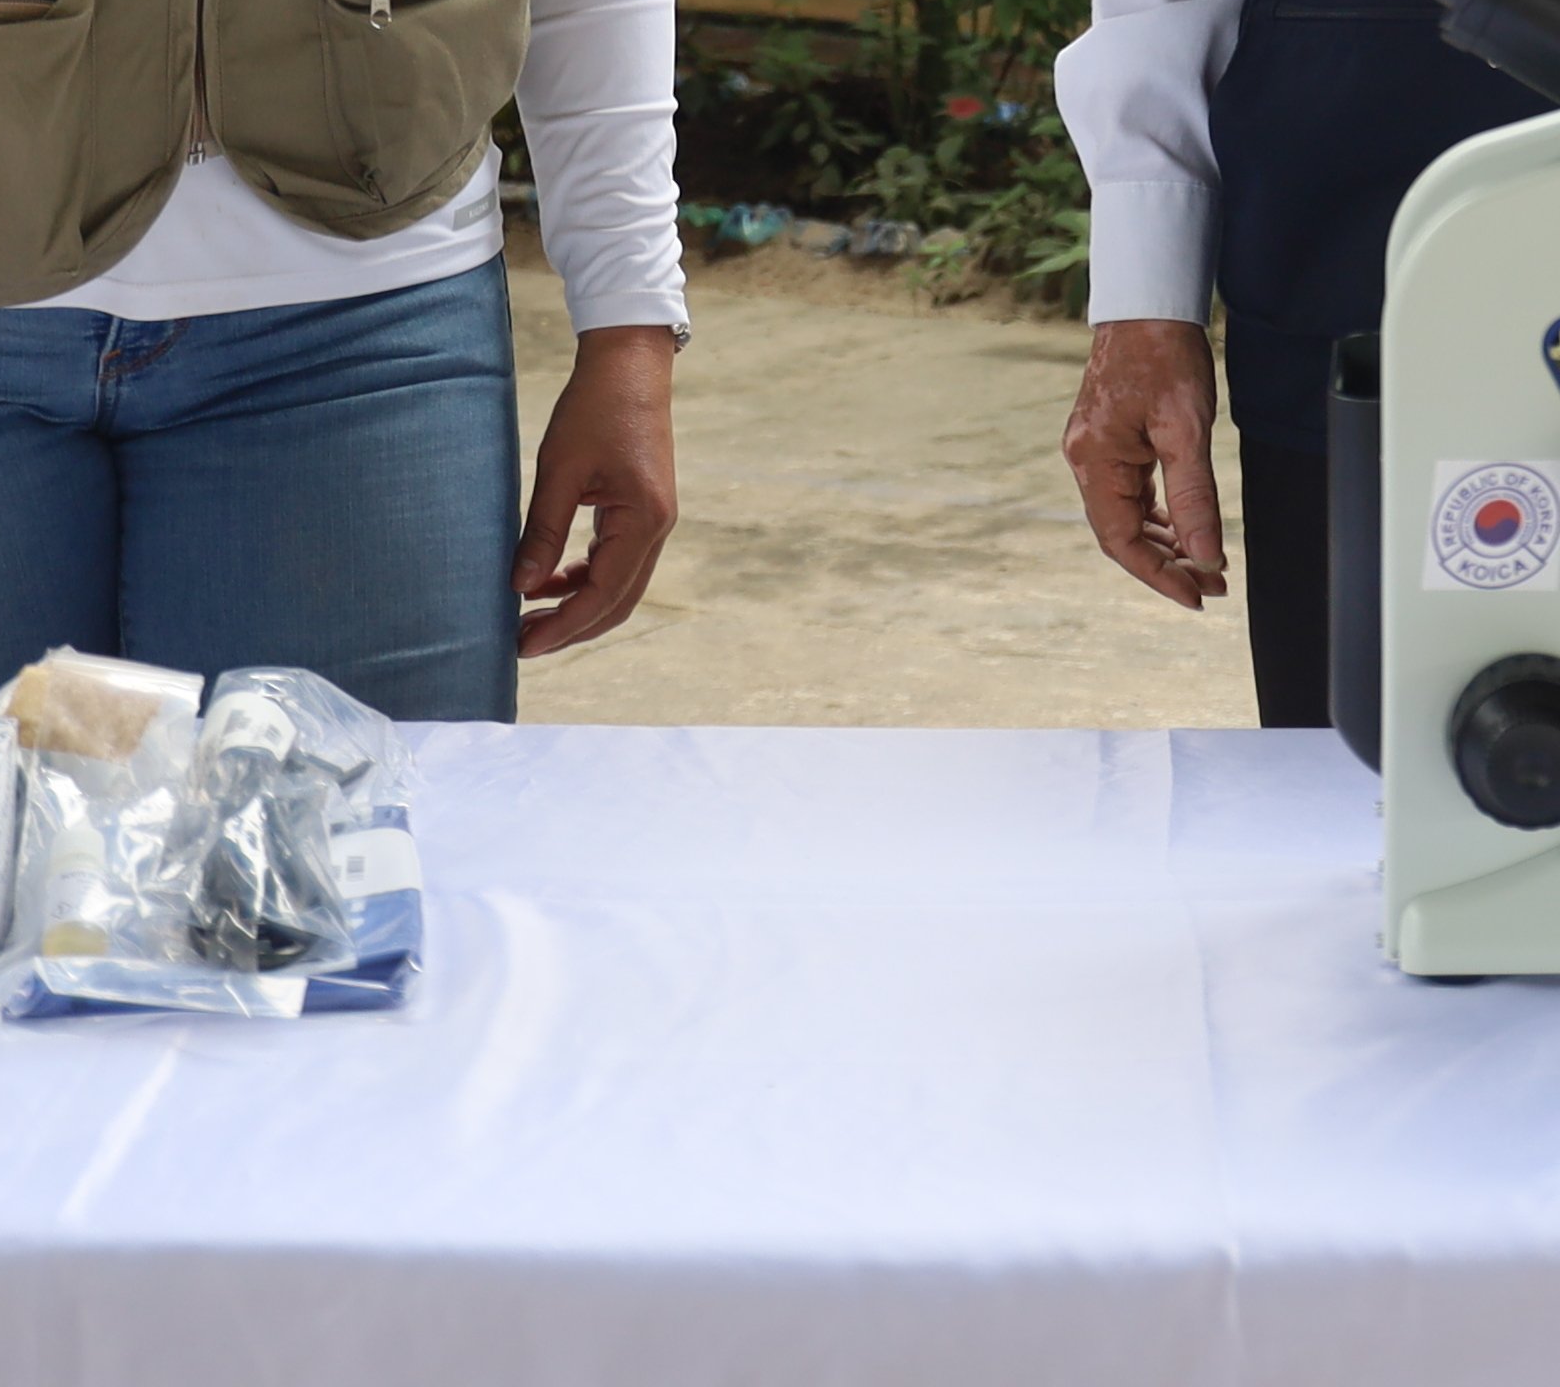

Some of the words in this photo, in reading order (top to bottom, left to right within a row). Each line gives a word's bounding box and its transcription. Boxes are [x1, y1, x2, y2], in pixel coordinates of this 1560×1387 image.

[1442, 473, 1498, 547] REPUBLIC
[1504, 473, 1530, 486] OF
[1531, 485, 1553, 545] KOREA
[1458, 559, 1528, 581] KOICA
